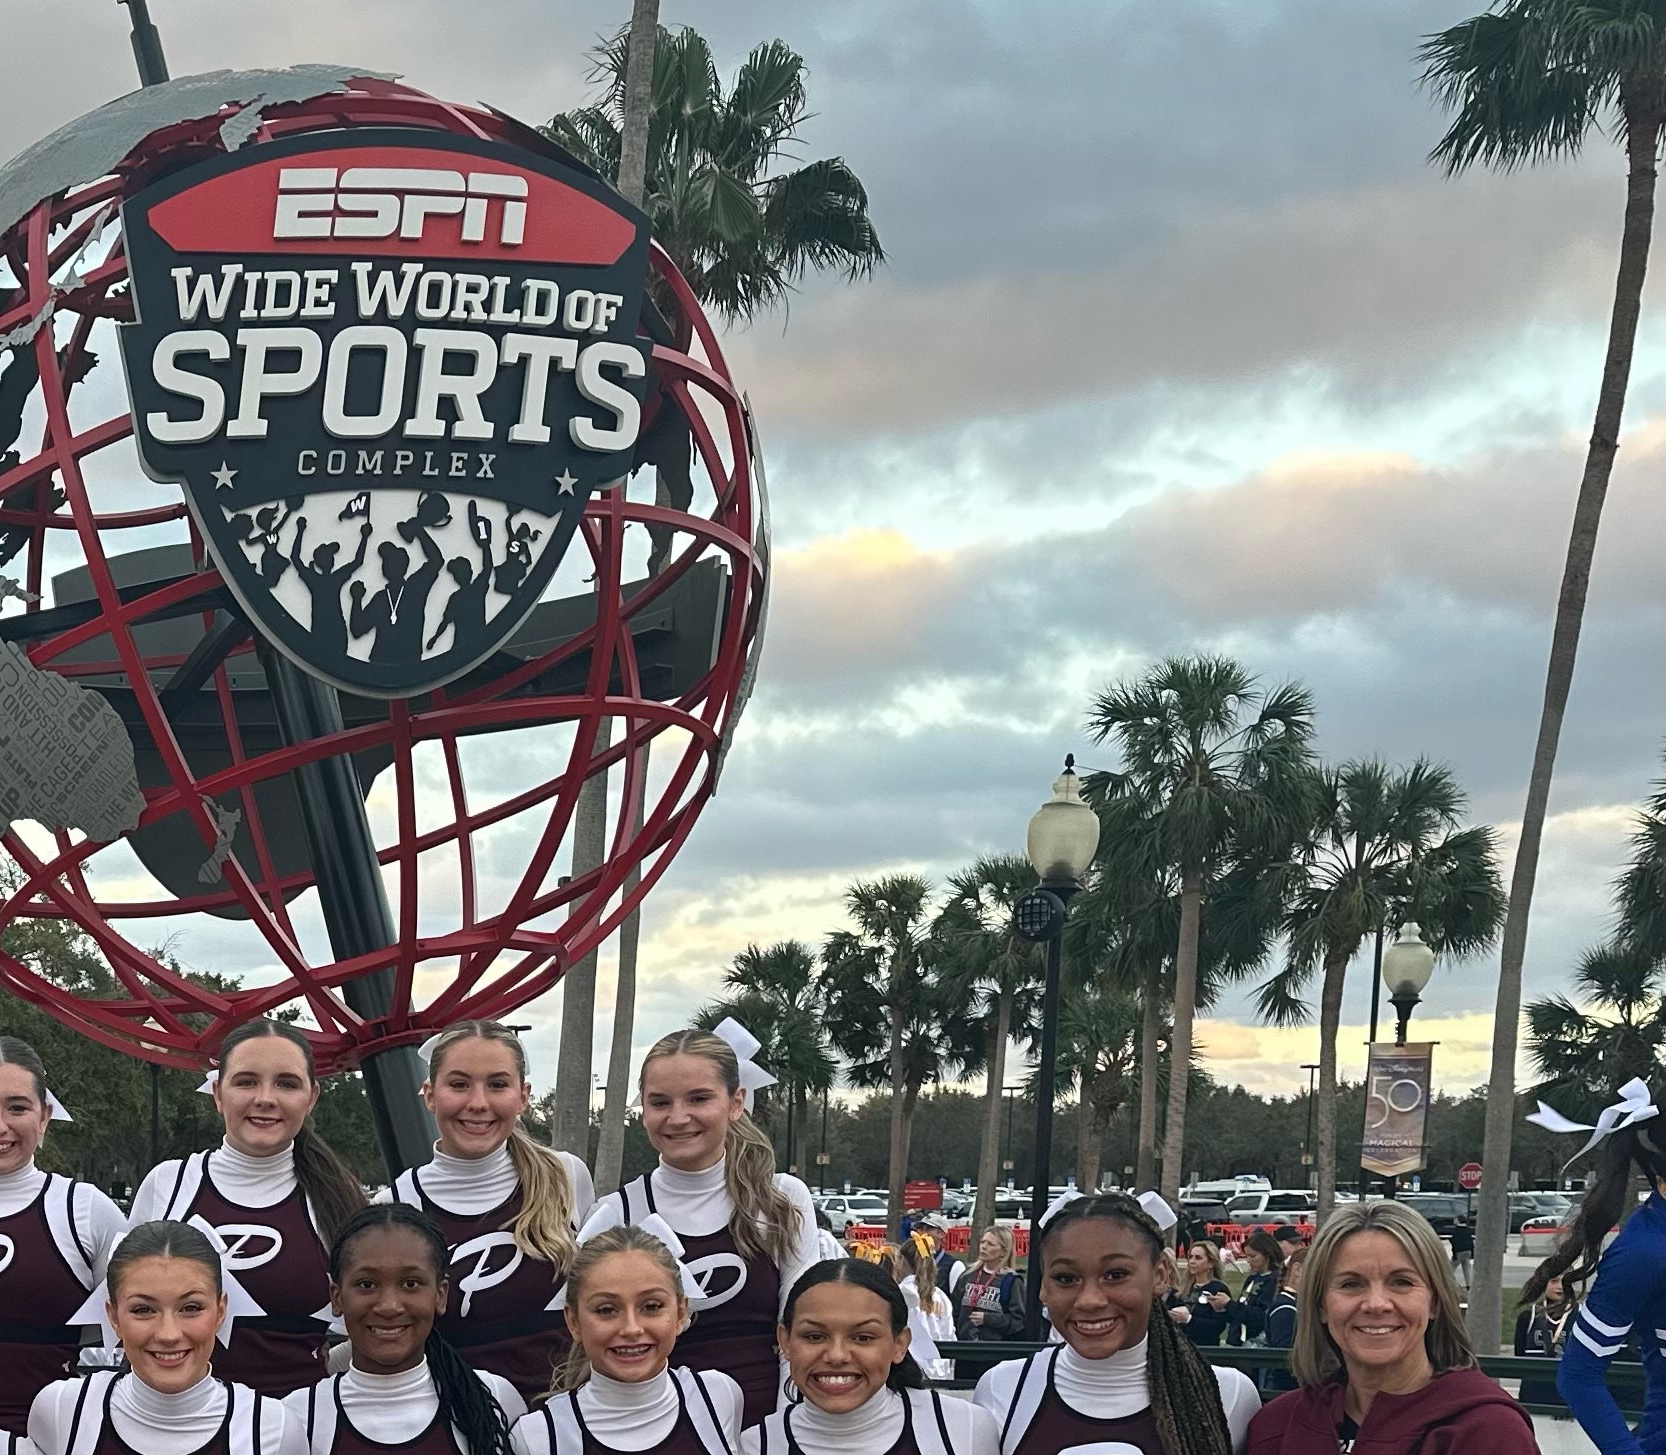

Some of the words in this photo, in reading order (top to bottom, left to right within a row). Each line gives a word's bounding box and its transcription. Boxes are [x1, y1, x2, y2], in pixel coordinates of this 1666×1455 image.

[274, 167, 529, 245] ESPN
[171, 264, 339, 322] WIDE
[350, 261, 560, 328] WORLD
[563, 289, 624, 335] OF
[146, 325, 647, 454] SPORTS
[297, 449, 498, 480] COMPLEX
[54, 738, 110, 806] SCREEN
[1371, 1076, 1422, 1129] 50
[1461, 1171, 1483, 1181] STOP
